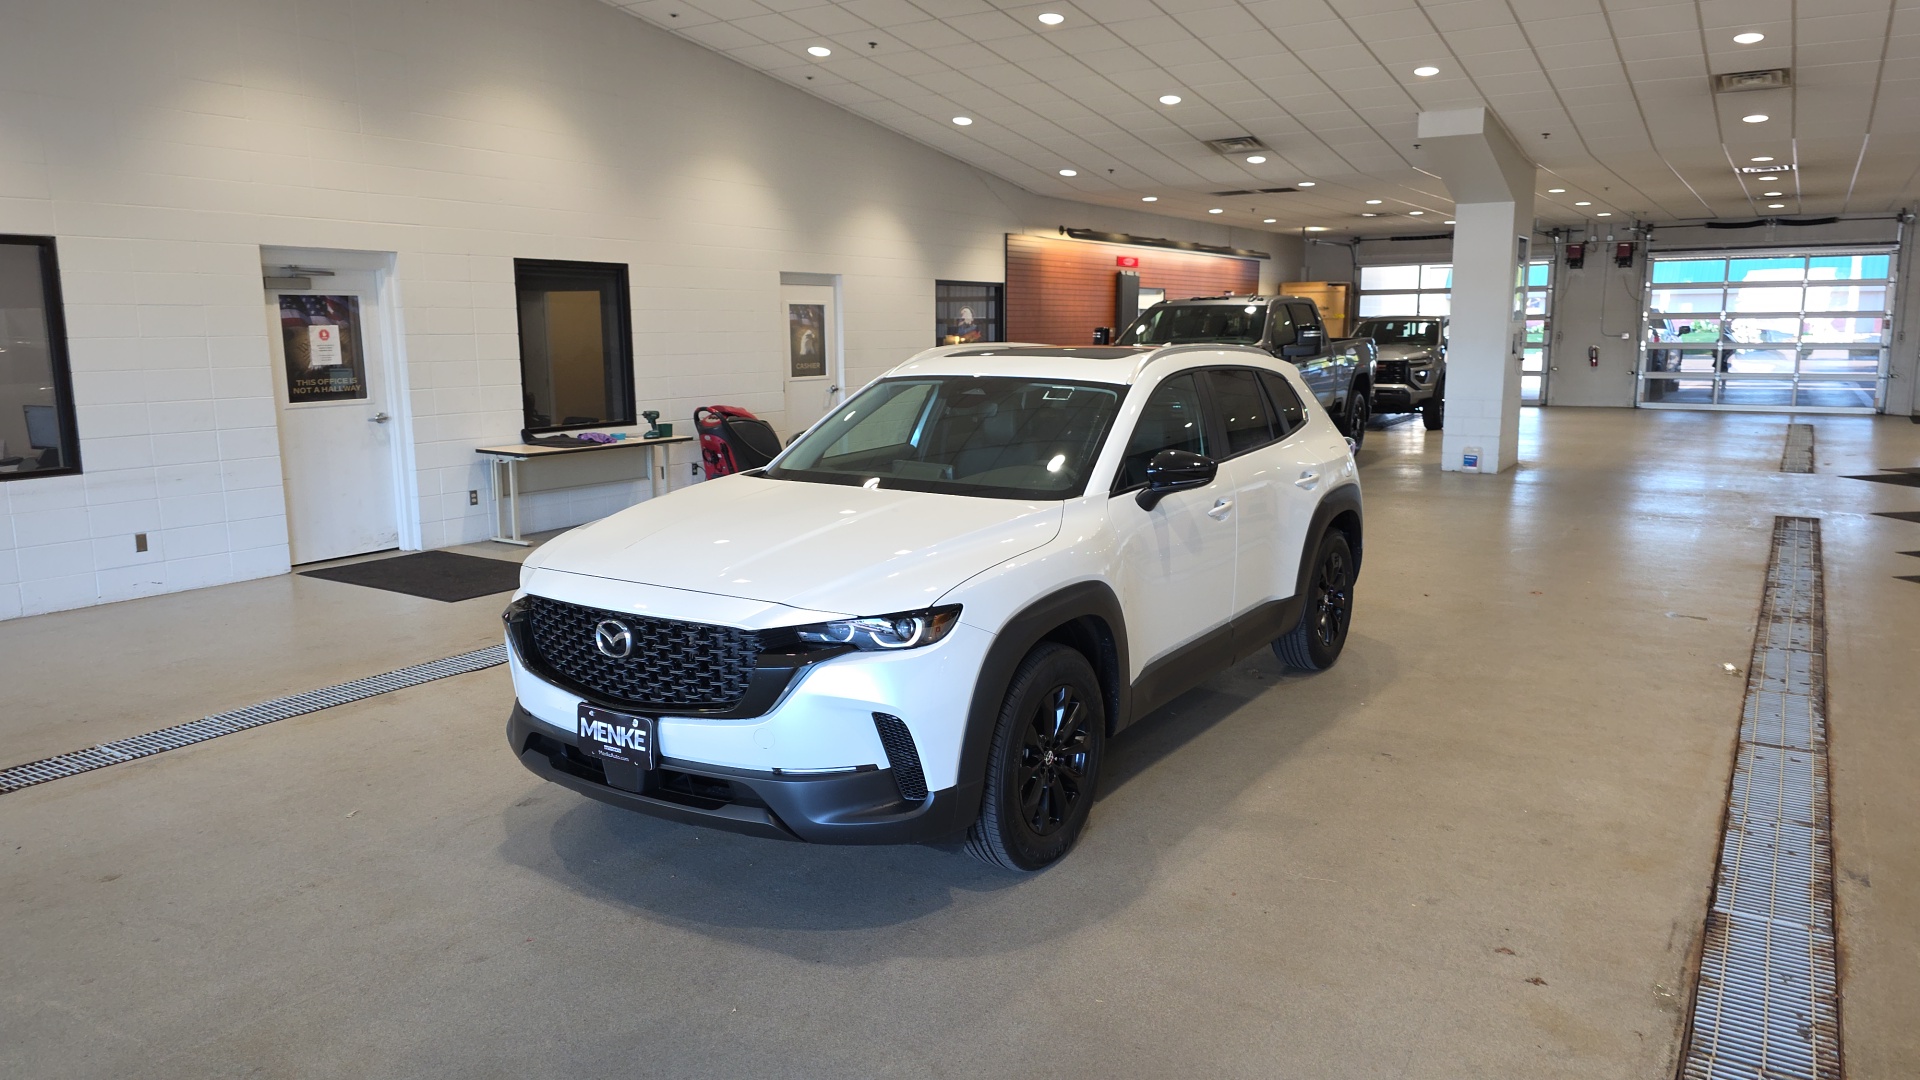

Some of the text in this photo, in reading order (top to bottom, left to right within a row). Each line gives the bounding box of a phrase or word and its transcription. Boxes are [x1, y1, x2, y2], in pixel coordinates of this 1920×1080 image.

[317, 377, 348, 385] OFFICE
[322, 385, 361, 393] HALLWAY
[581, 717, 646, 752] MENKE
